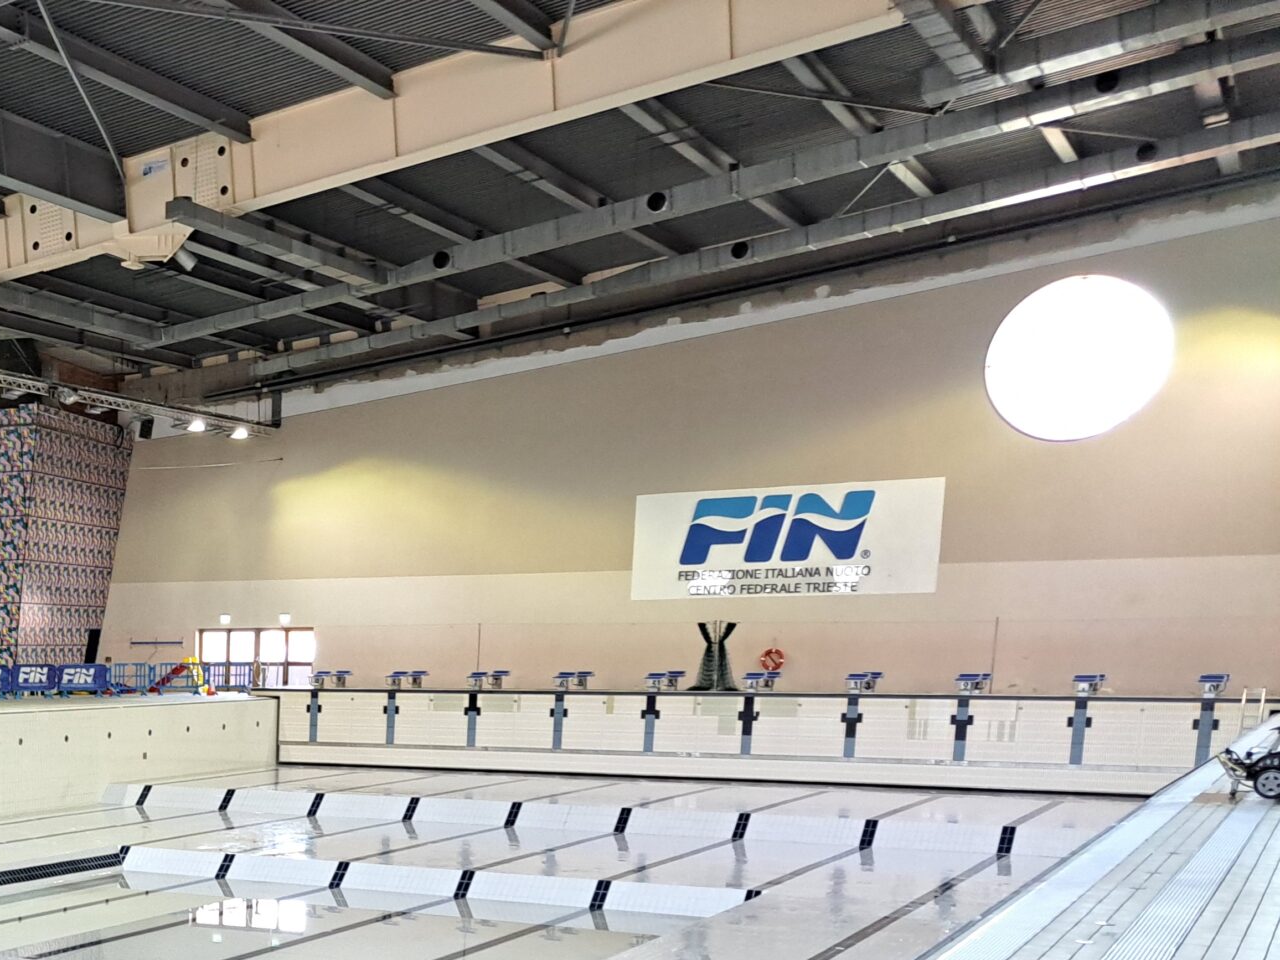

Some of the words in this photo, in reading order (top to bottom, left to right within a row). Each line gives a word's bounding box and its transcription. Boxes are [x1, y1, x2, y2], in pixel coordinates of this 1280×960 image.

[679, 490, 876, 565] FIN
[764, 566, 822, 580] ITALIANA
[825, 565, 871, 577] NUOTO
[688, 583, 736, 596] CENTRO
[740, 582, 802, 595] FEDERALE
[805, 581, 859, 593] TRIESTE
[18, 666, 48, 683] FIN
[61, 668, 95, 684] FIN
